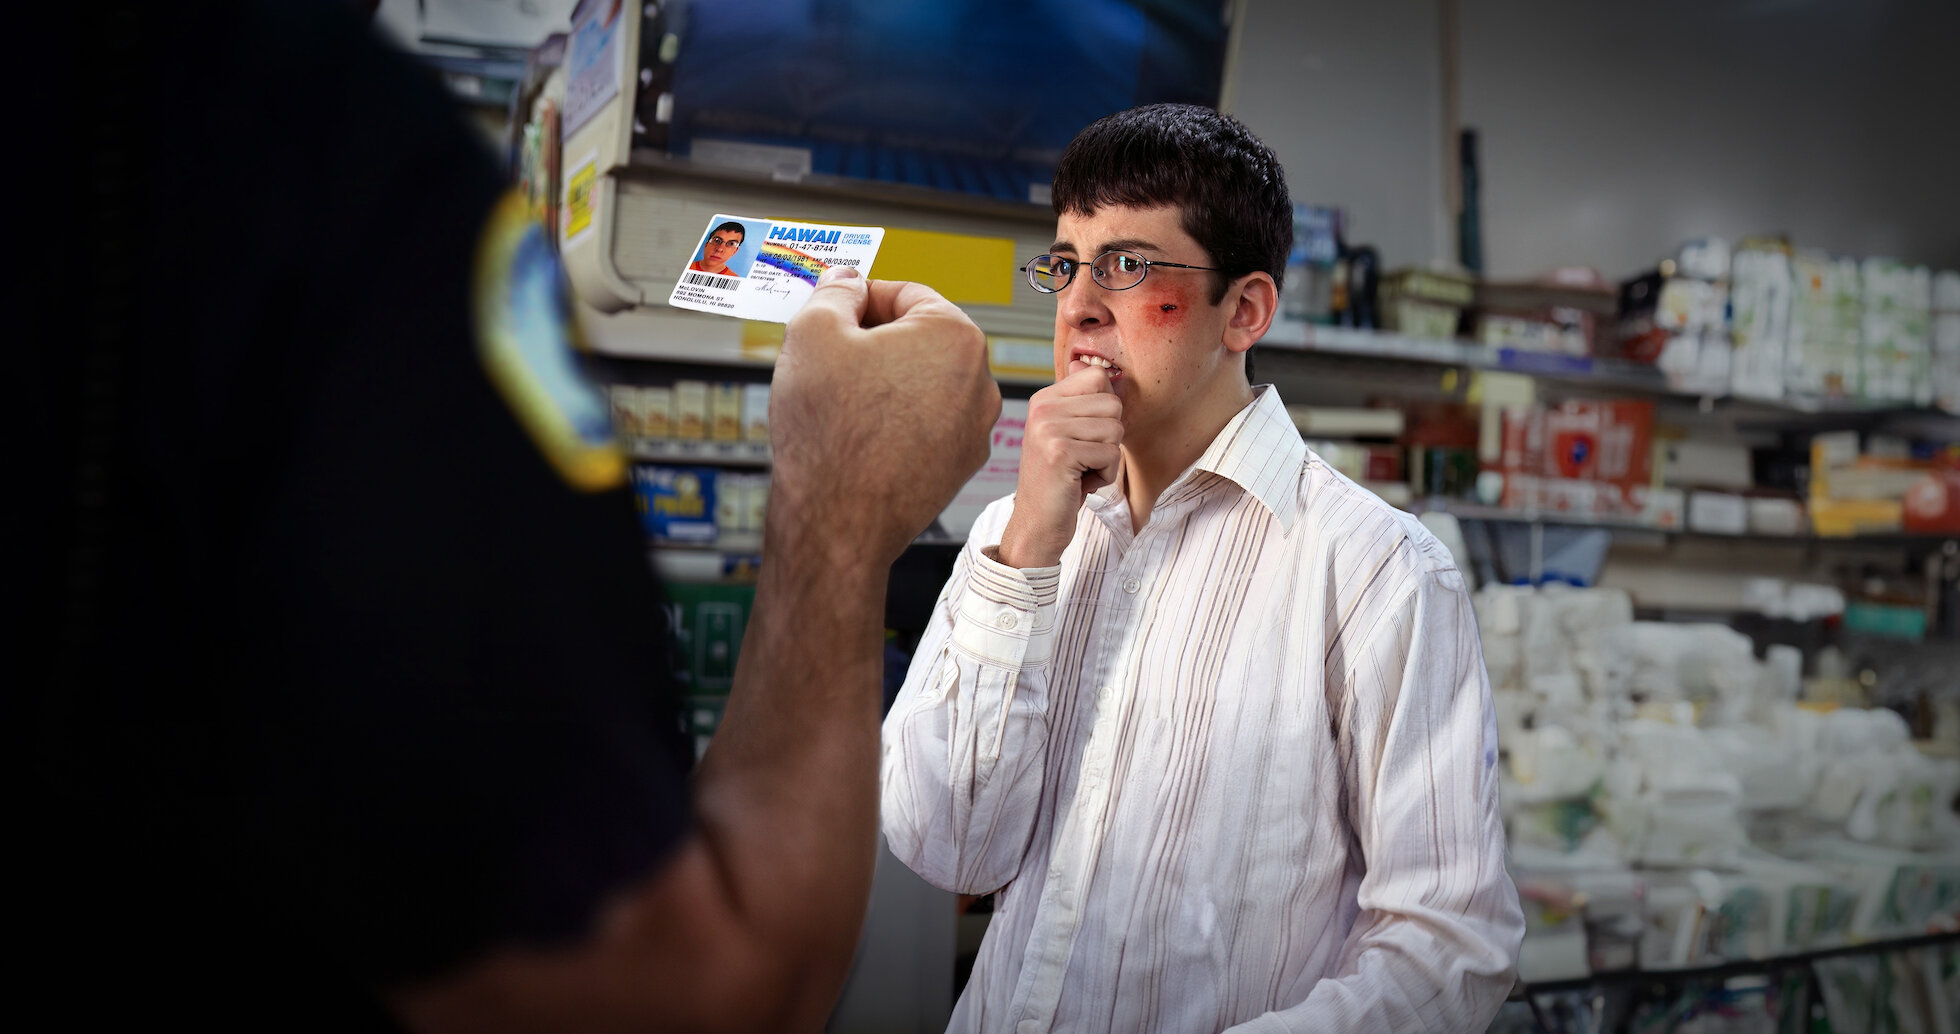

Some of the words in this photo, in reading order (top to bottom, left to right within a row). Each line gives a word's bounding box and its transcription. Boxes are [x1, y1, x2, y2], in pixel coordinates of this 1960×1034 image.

[769, 226, 841, 244] HAWAII
[790, 242, 838, 252] 01-47-87441
[688, 292, 714, 300] MOMONA
